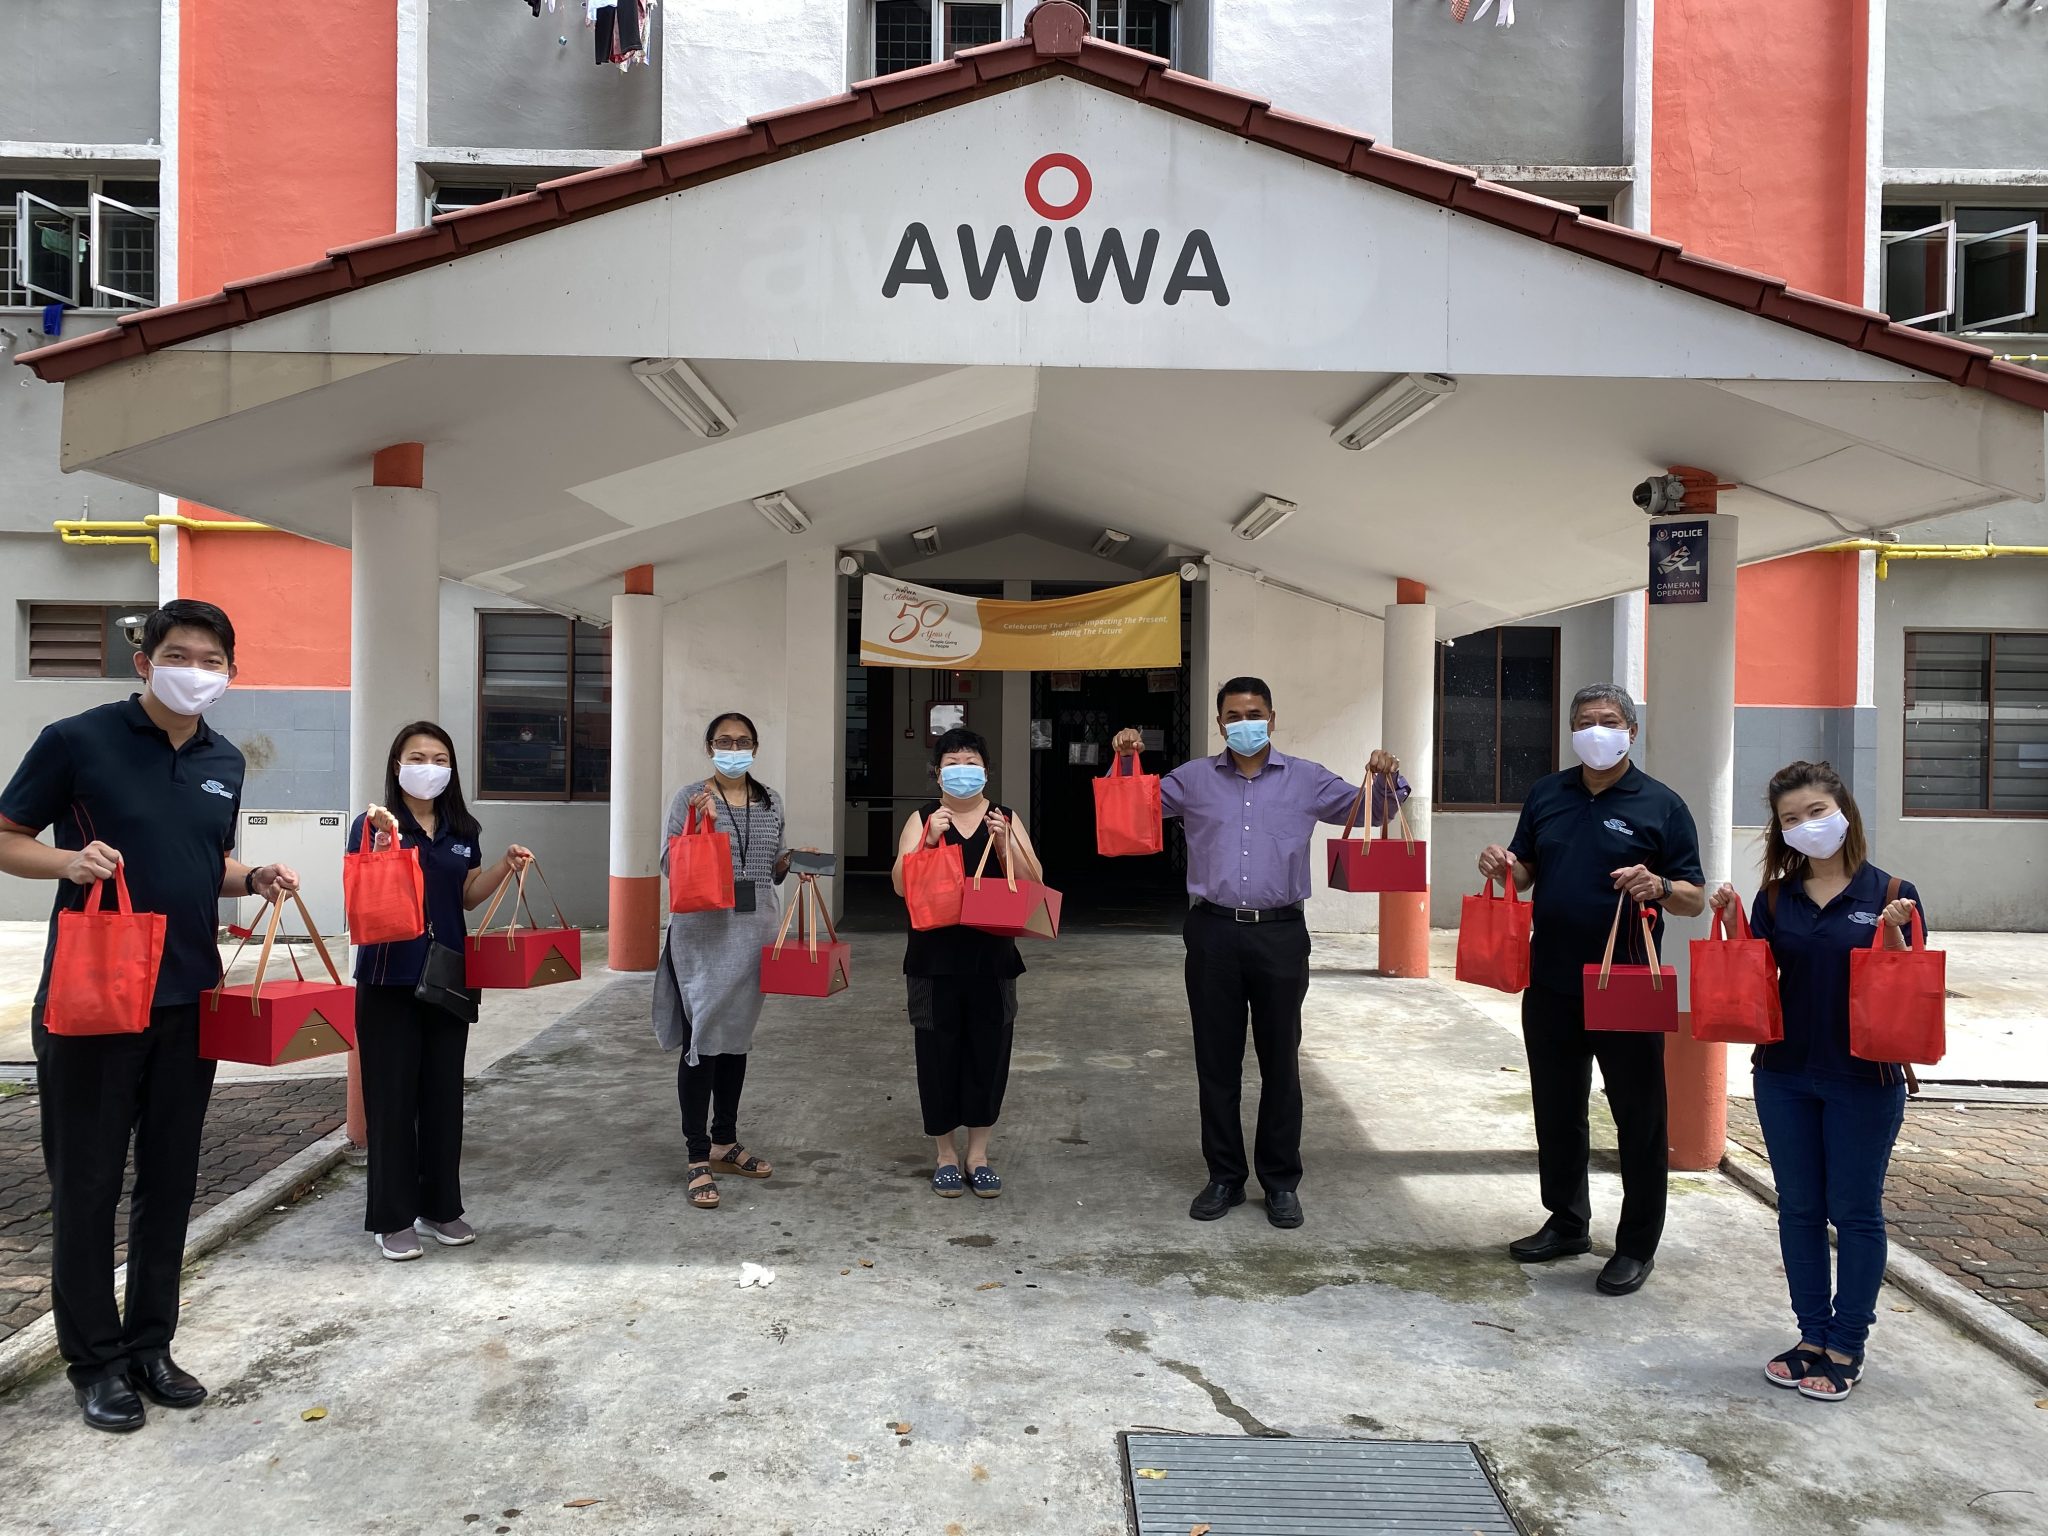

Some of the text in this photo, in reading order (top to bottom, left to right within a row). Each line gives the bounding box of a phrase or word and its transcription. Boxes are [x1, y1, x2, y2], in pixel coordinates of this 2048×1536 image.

[881, 221, 1231, 307] AWWA
[1671, 528, 1703, 539] POLICE
[1656, 582, 1690, 590] CAMERA
[1656, 588, 1700, 597] OPERATION
[889, 599, 949, 643] 50
[1084, 618, 1123, 627] Impacting
[1124, 616, 1137, 624] The
[1051, 628, 1081, 638] Shaping
[1098, 627, 1122, 635] Future
[248, 816, 267, 824] 4023
[320, 817, 338, 825] 4021
